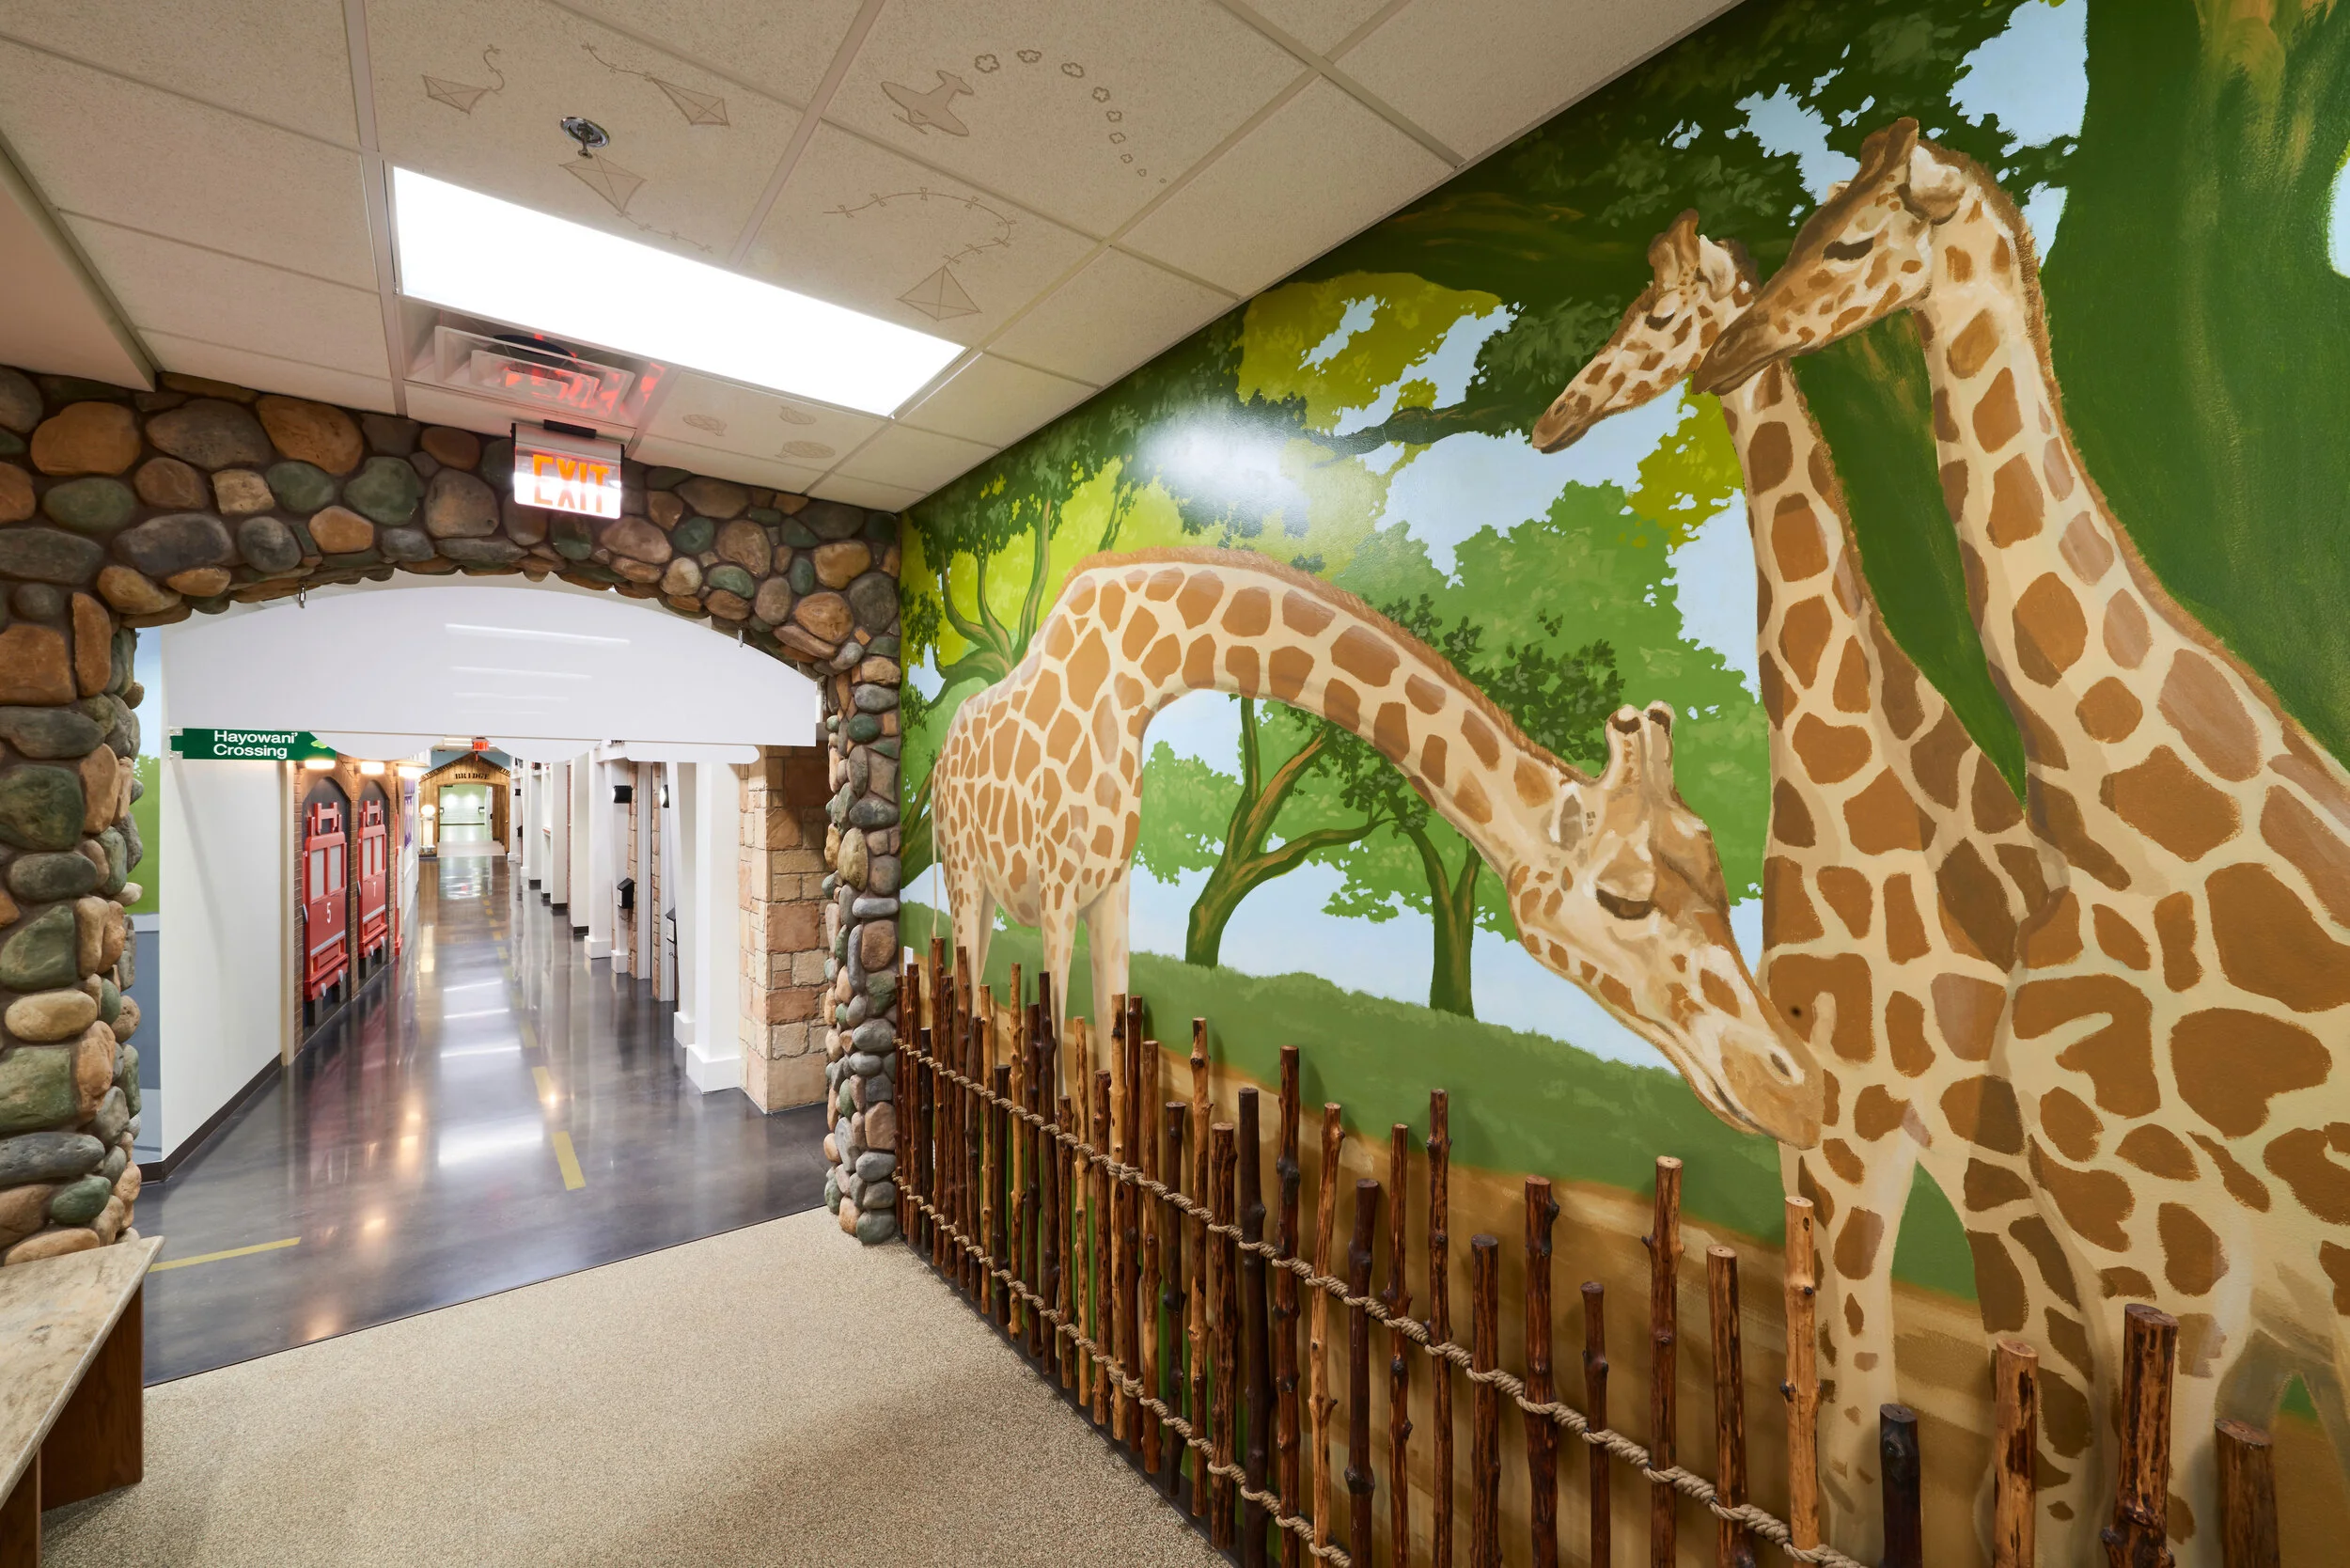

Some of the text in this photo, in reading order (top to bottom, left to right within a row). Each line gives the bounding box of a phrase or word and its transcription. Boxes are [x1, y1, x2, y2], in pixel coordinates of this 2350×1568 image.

[533, 454, 610, 514] EXIT
[213, 729, 299, 745] Hayowani'
[212, 743, 288, 760] Crossing
[455, 772, 490, 780] BRIDGE
[326, 902, 332, 924] 5
